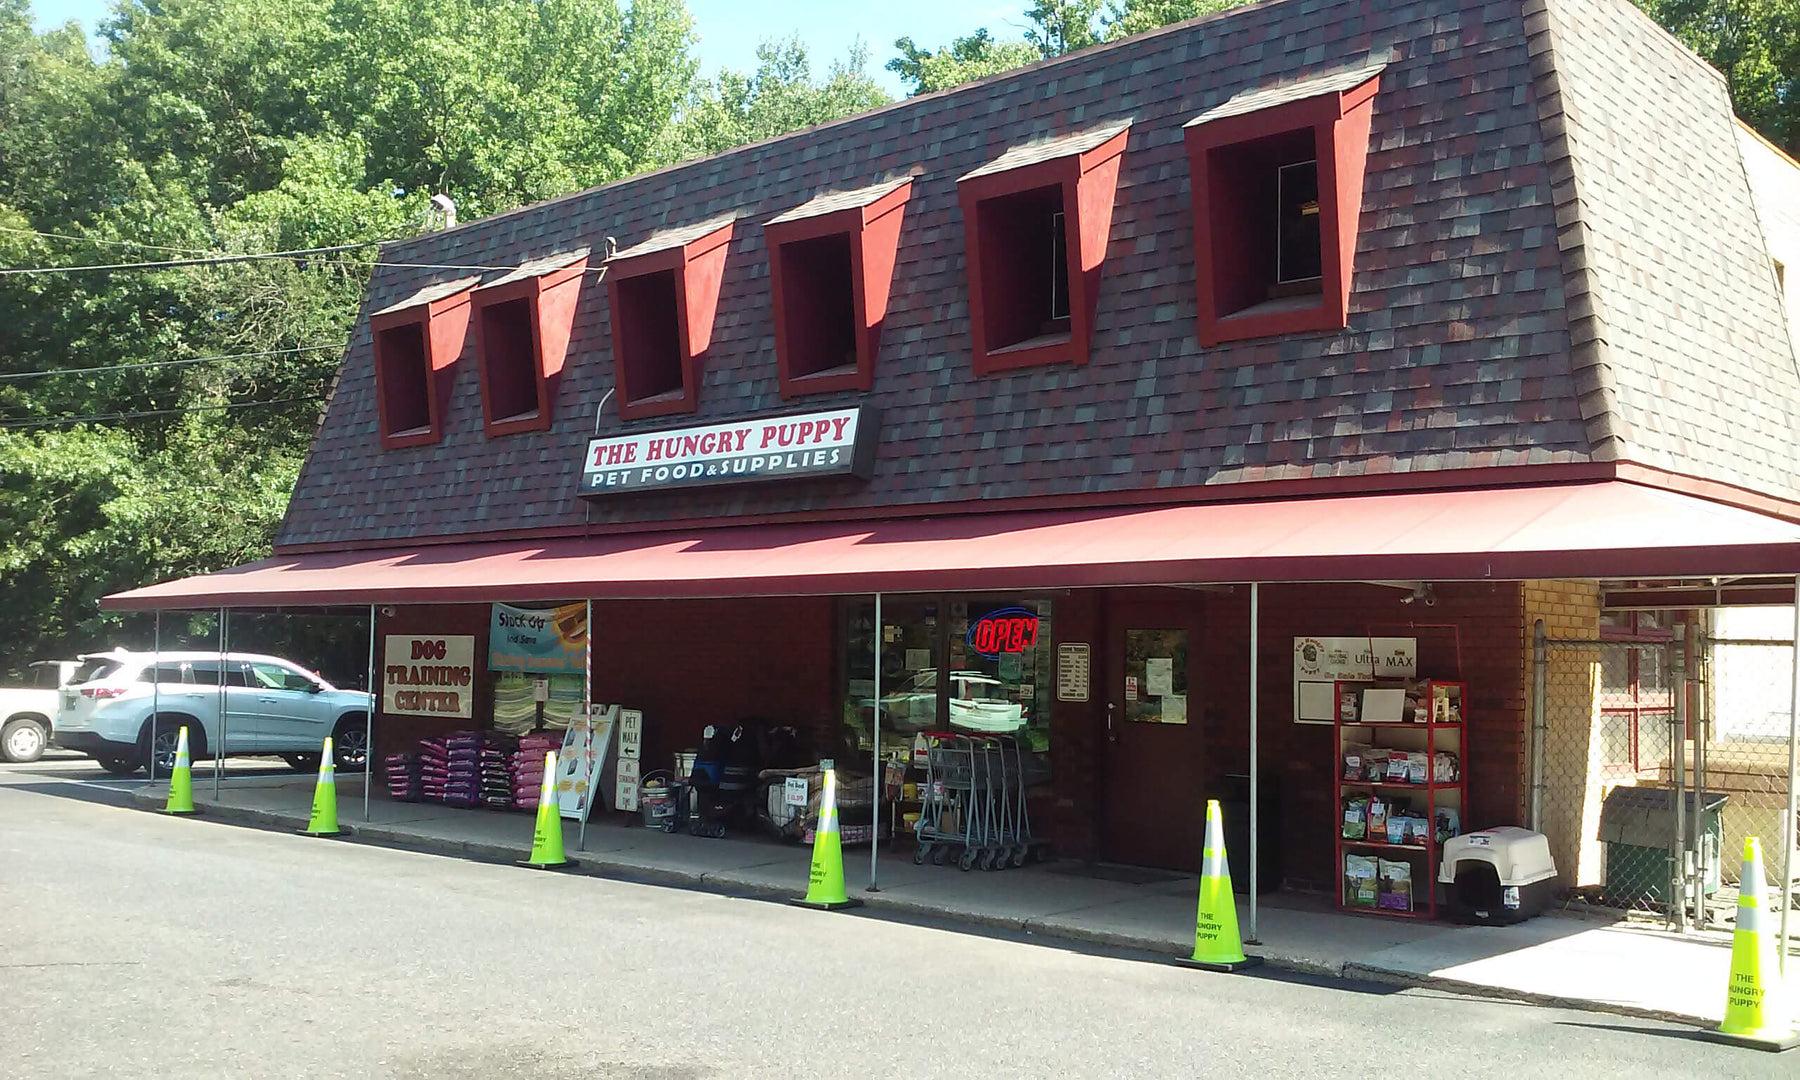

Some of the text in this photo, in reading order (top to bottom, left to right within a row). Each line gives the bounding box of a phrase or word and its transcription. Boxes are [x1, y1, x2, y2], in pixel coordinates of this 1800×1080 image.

[593, 416, 850, 466] THE HUNGRY PUPPY
[591, 470, 631, 487] PET
[499, 612, 526, 628] Stock
[975, 618, 1038, 652] OPEN
[411, 640, 447, 660] DOG
[1386, 657, 1413, 667] MAX
[387, 665, 471, 686] TRAINING
[395, 690, 460, 712] CENTER
[625, 716, 637, 729] PET
[622, 731, 639, 744] WALK
[1201, 912, 1214, 920] THE
[1197, 932, 1218, 940] PUPPY
[1736, 973, 1754, 983] THE
[1729, 997, 1760, 1008] PUPPY
